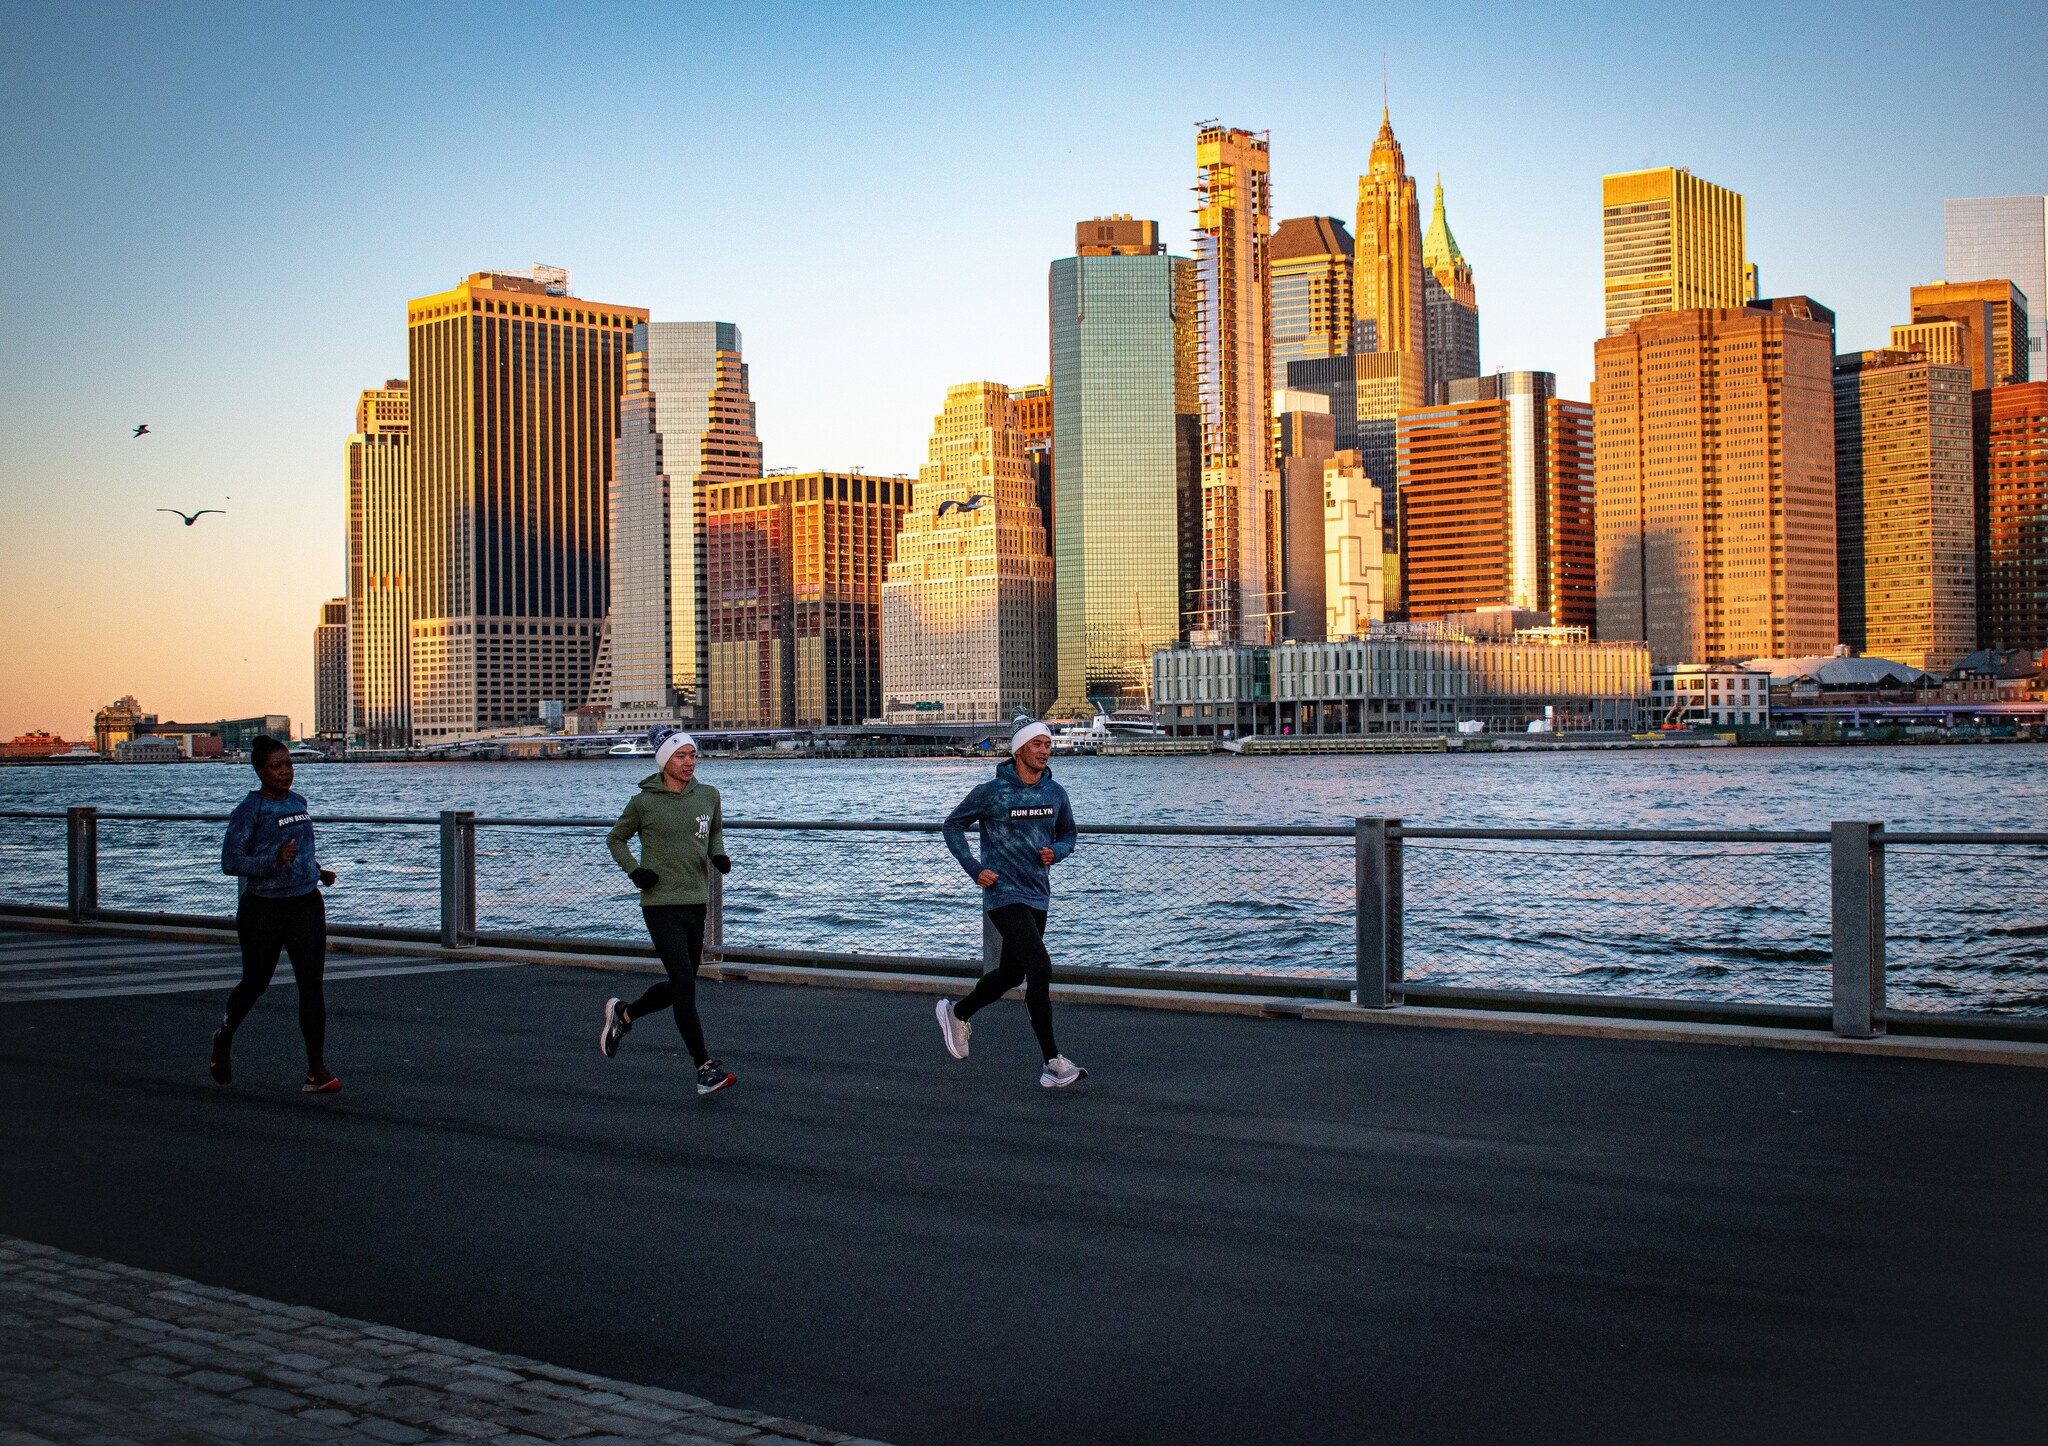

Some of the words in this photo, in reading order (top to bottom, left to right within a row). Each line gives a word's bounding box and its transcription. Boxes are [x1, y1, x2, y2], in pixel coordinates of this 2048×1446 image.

[1029, 808, 1053, 816] BKLYN
[278, 816, 294, 827] RUN
[695, 814, 710, 823] RUN
